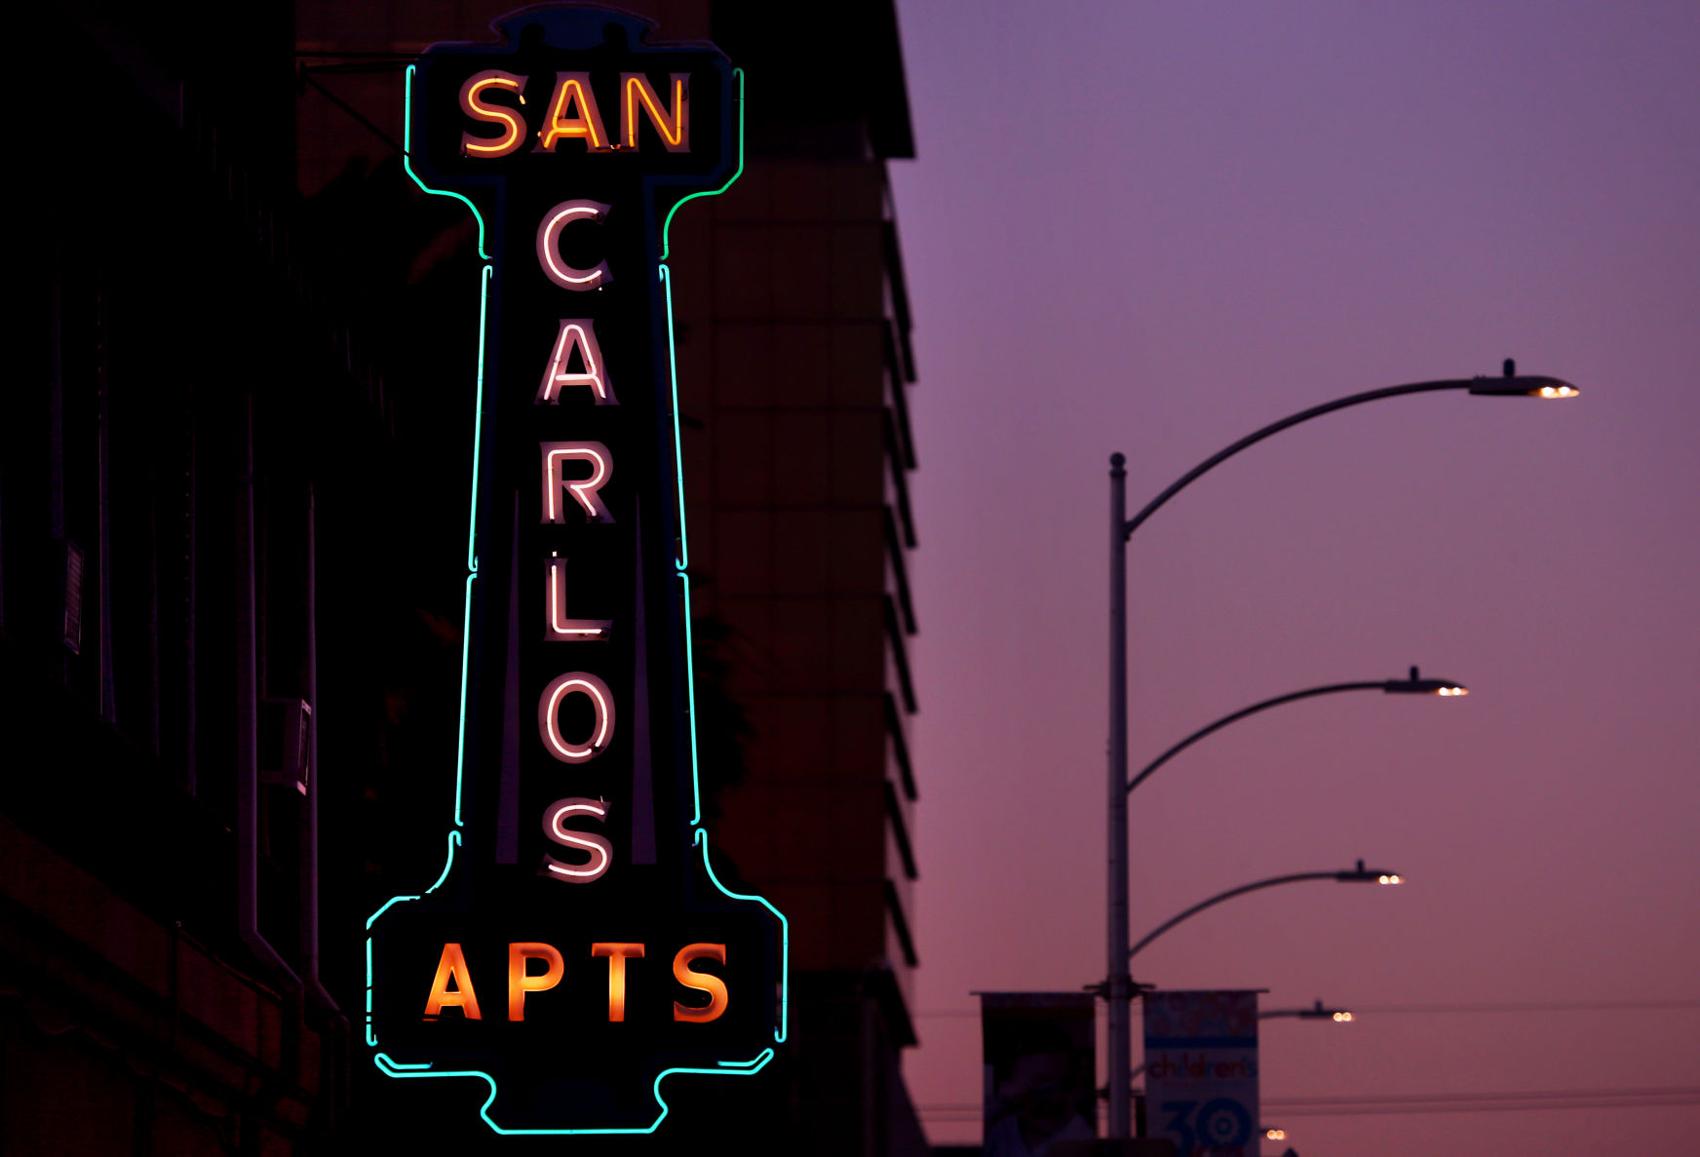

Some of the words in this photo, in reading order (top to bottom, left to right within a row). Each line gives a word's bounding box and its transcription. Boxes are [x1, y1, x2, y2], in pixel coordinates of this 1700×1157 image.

[458, 69, 693, 159] SAN
[535, 199, 619, 884] CARLOS
[423, 942, 728, 1023] APTS
[1163, 1098, 1251, 1156] 30
